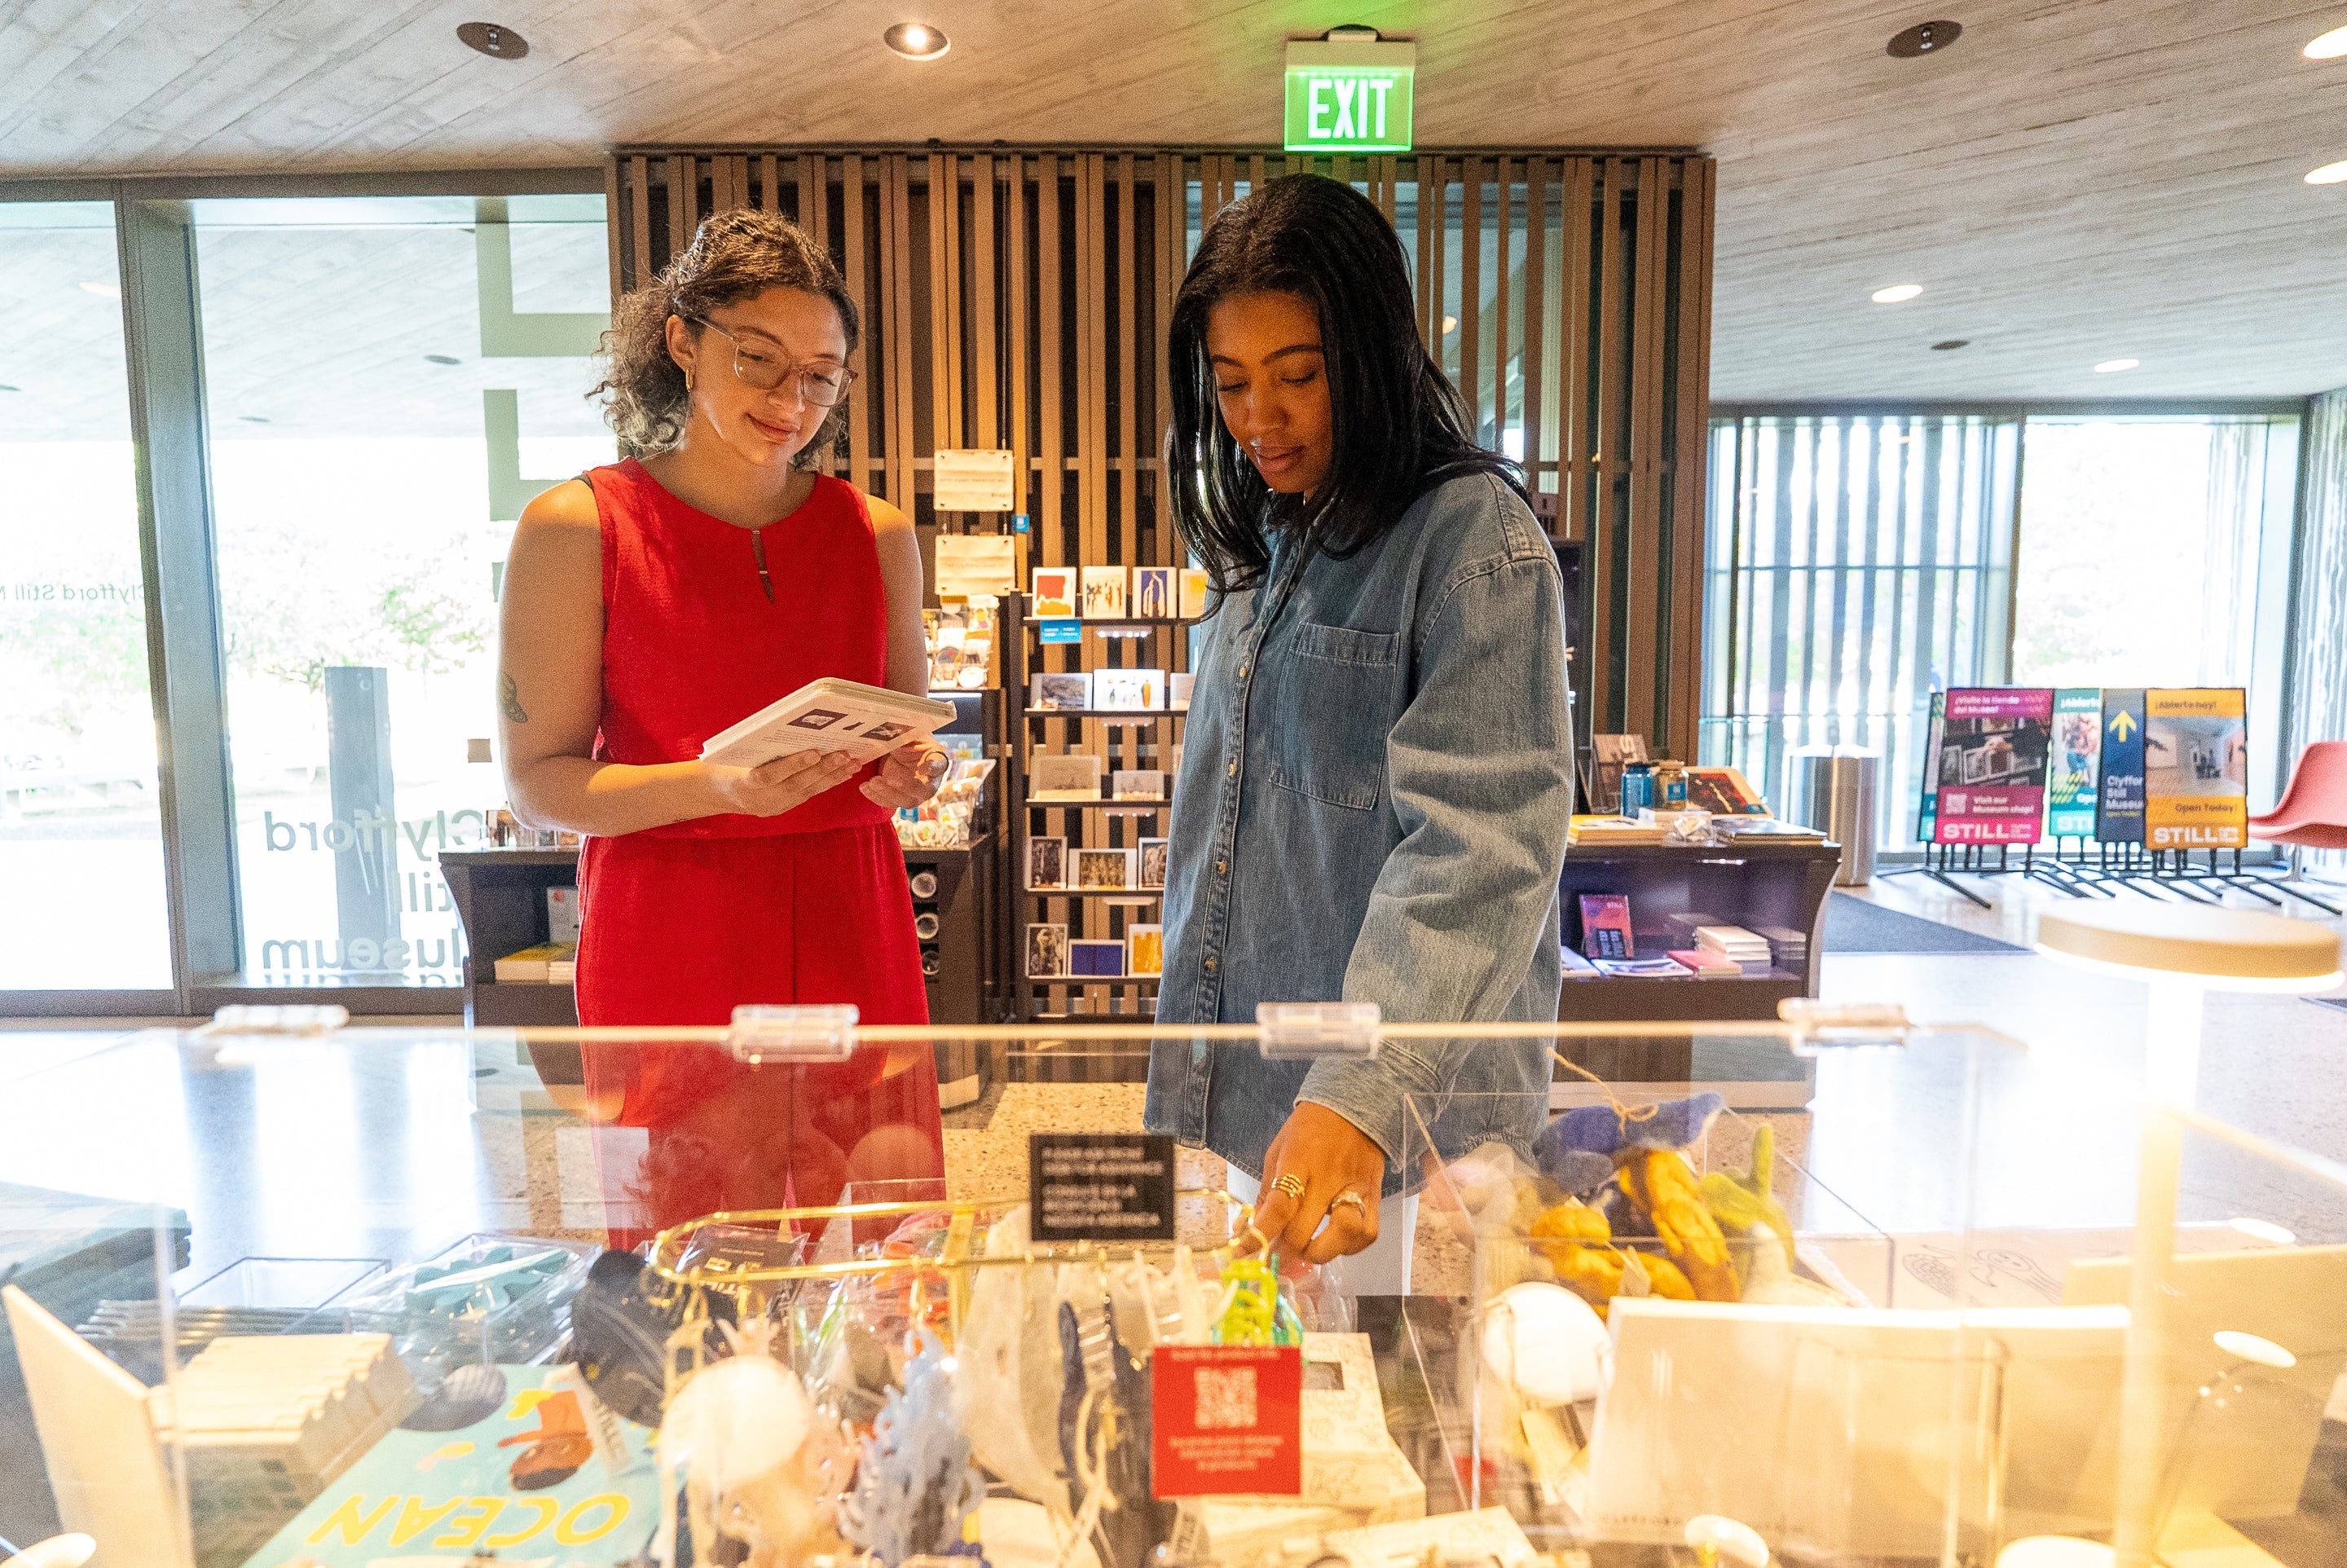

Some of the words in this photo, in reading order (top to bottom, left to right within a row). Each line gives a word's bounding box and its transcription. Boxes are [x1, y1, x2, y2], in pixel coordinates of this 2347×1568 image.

[1307, 78, 1394, 139] EXIT
[2107, 775, 2143, 787] Clyffor
[2107, 787, 2127, 799] Still
[1973, 796, 1993, 804] Visit
[1993, 796, 2009, 804] our
[2106, 799, 2143, 810] Museu
[1972, 805, 2010, 813] Museum
[2175, 803, 2201, 814] Open
[2056, 816, 2094, 831] STI
[1943, 823, 2009, 839] STILL
[2154, 826, 2218, 843] STILL
[305, 1492, 632, 1548] OCEAN
